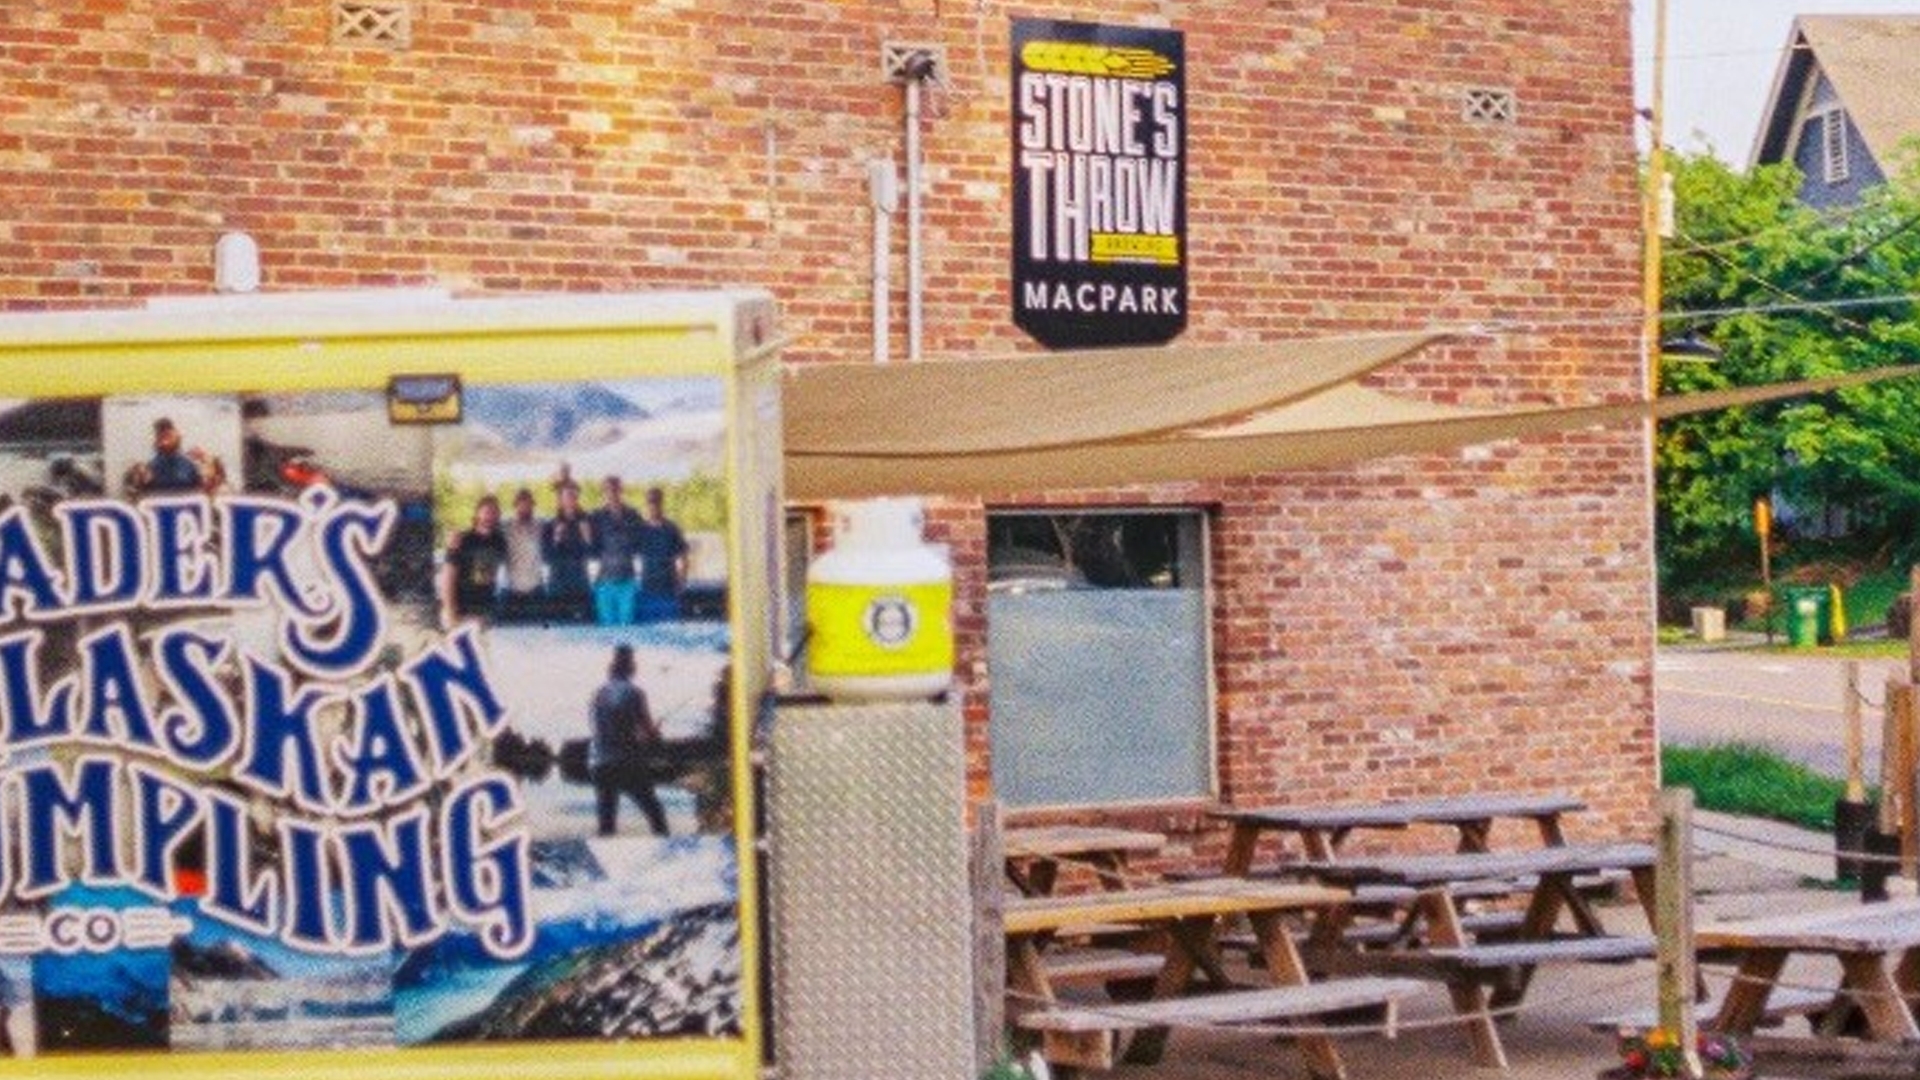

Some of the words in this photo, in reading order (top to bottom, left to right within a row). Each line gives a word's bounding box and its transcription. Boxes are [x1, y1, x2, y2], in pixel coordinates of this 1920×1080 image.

[1020, 73, 1178, 157] STONE'S
[1020, 152, 1178, 261] THROW
[1024, 282, 1178, 315] MACPARK
[1, 630, 505, 804] LASKAN
[0, 760, 525, 946] MPLING
[50, 914, 116, 944] CO
